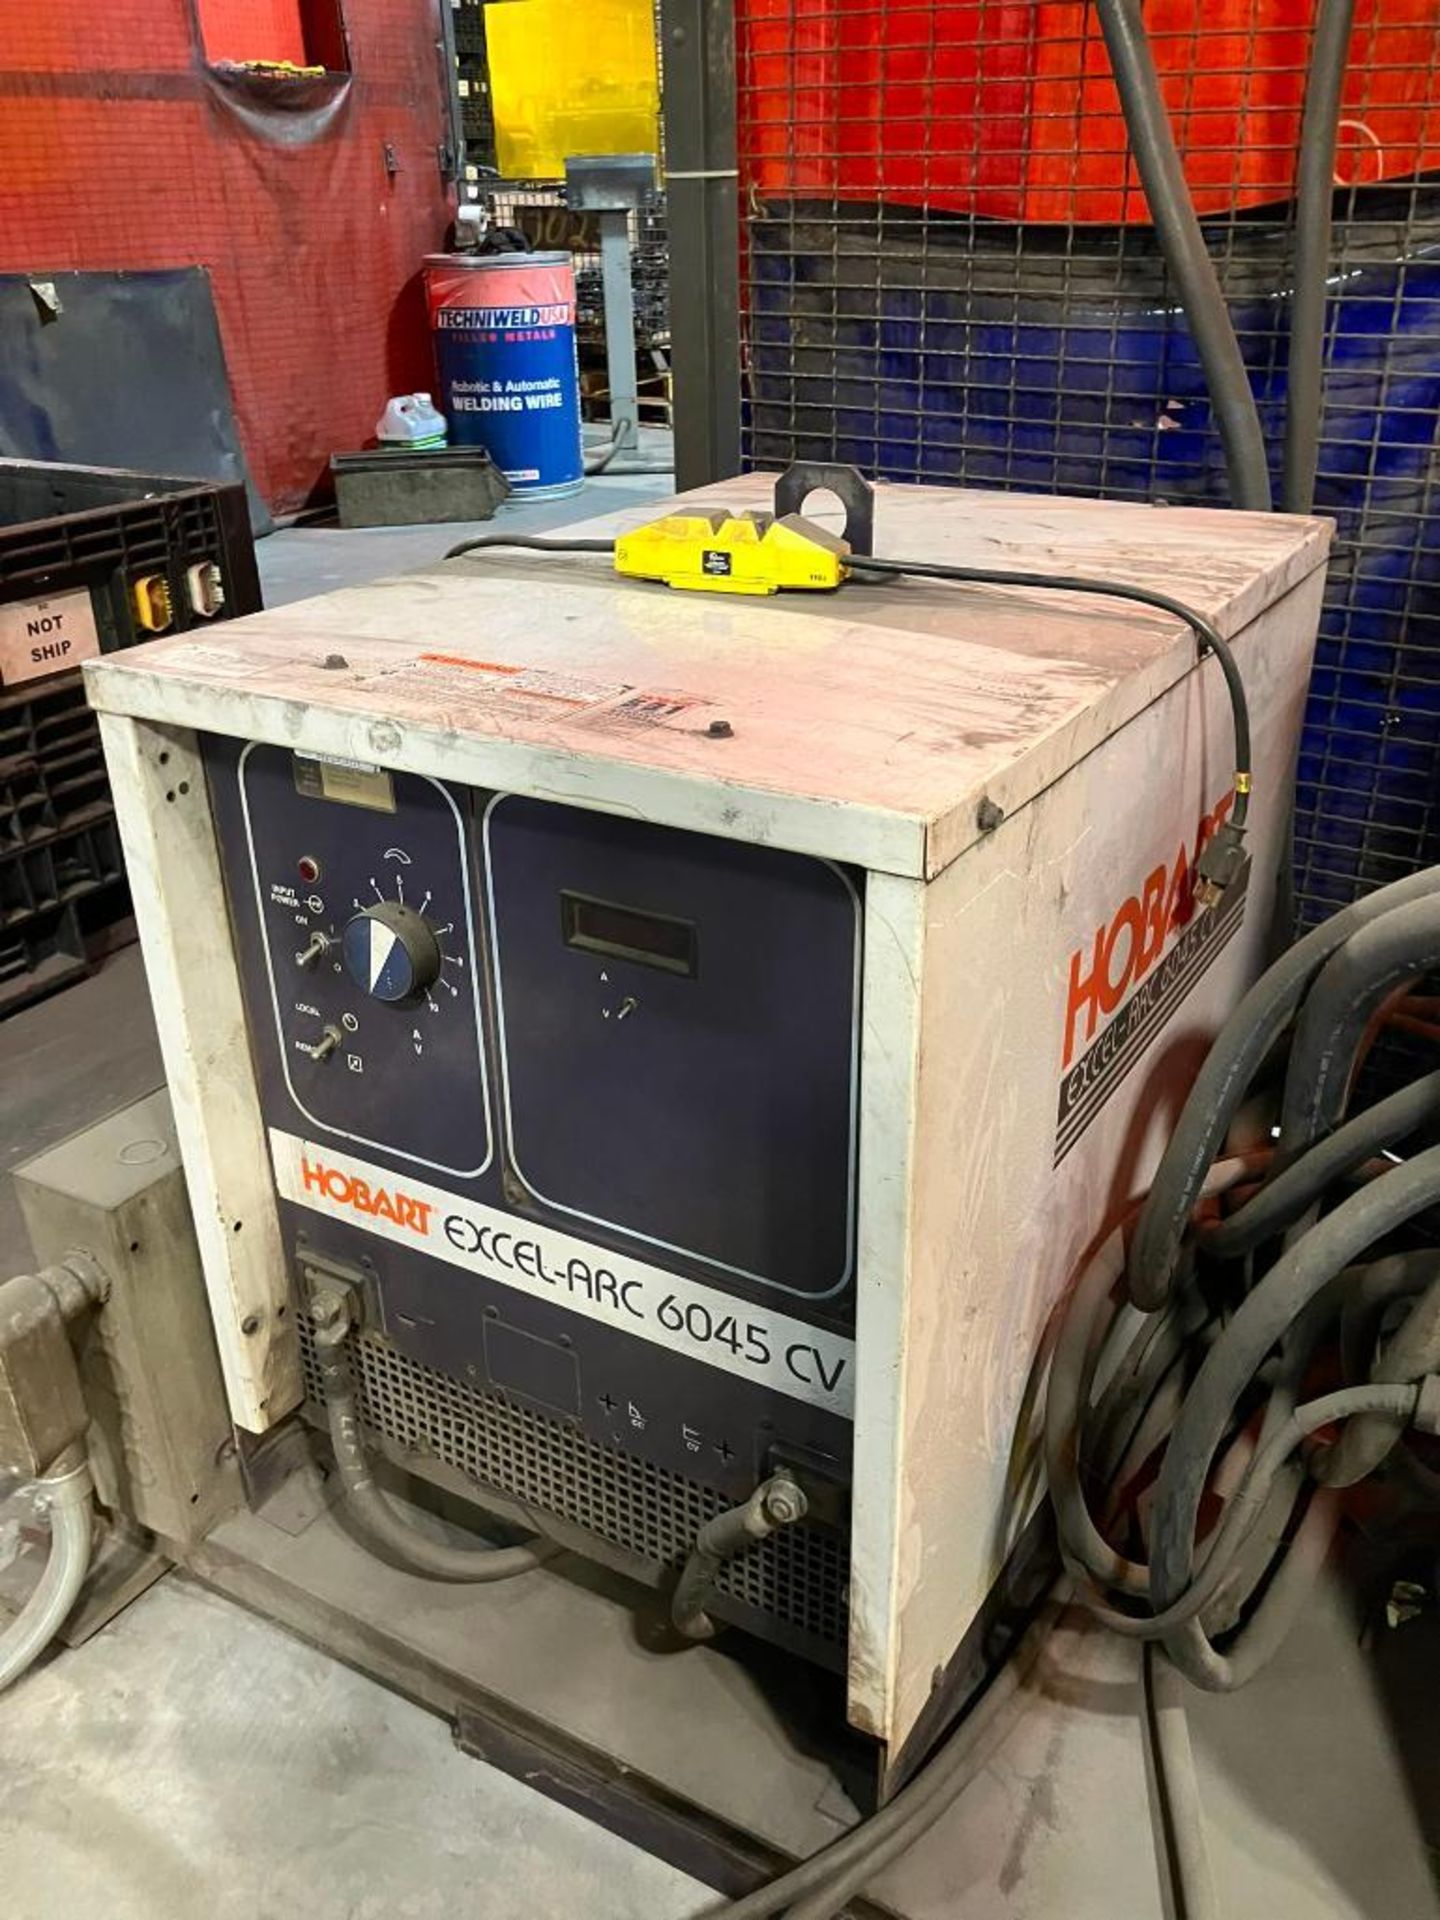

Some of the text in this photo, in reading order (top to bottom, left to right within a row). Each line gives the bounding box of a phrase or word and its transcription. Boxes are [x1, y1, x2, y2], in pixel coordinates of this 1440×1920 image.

[493, 381, 502, 392] &
[505, 377, 560, 393] Automatic
[453, 392, 562, 411] WELDING WIRE
[27, 615, 63, 637] NOT
[31, 640, 72, 662] SHIP
[301, 1157, 847, 1393] HOBART EXCEL-ARC 6045 CV
